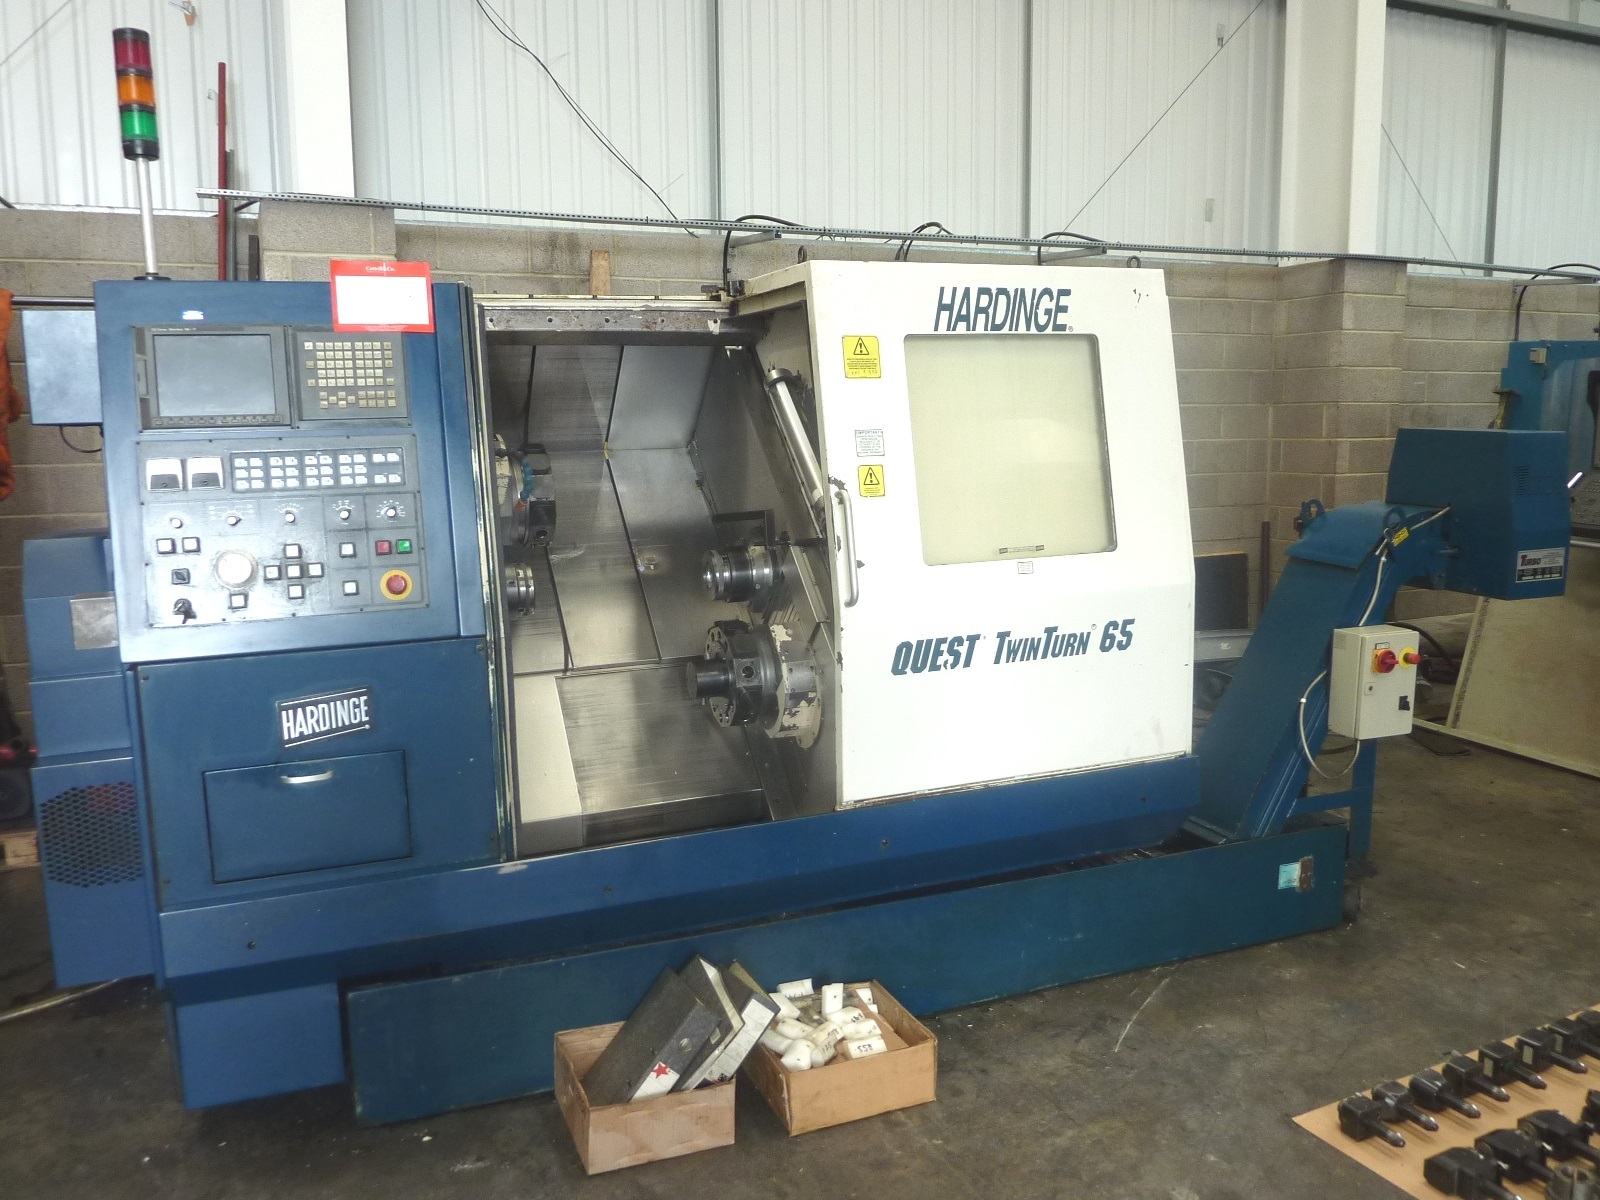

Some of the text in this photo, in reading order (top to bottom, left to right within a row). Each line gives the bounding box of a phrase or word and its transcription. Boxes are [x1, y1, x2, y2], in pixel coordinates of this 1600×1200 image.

[934, 286, 1072, 332] HARDINGE
[891, 633, 981, 676] QUEST
[1099, 618, 1136, 652] 65
[281, 695, 370, 740] HARDINGE
